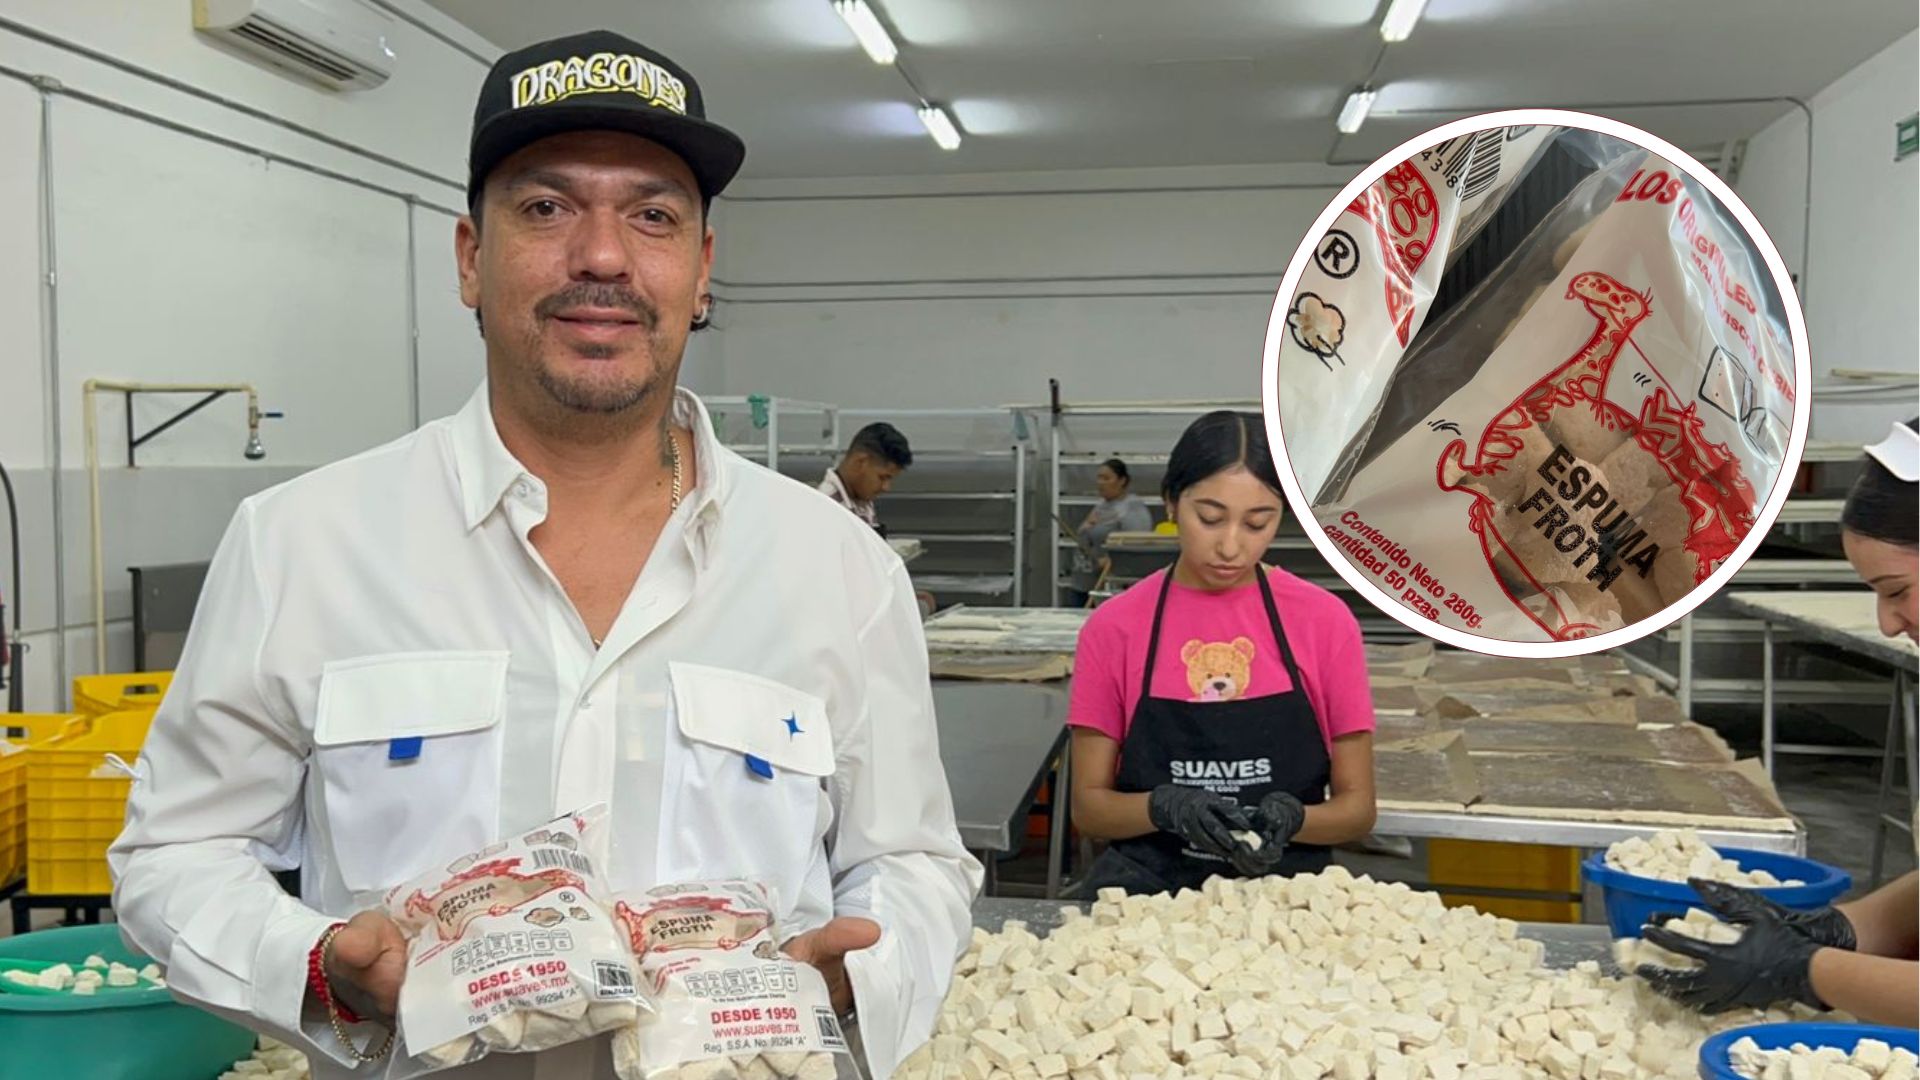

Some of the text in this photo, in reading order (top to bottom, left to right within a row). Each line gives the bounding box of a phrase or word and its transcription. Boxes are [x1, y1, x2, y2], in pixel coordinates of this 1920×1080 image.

[510, 52, 687, 116] DRAGONES
[1615, 169, 1685, 205] LOS
[1537, 443, 1660, 579] ESPUMA
[1517, 487, 1623, 593] FROTH
[1323, 525, 1440, 624] cantidad 50 pzas.
[1340, 511, 1482, 629] Contenido Neto 280g.
[1170, 758, 1271, 778] SUAVES
[437, 883, 496, 922] ESPUMA
[651, 914, 716, 935] ESPUMA
[660, 924, 713, 940] FROTH
[526, 960, 566, 977] 1950
[711, 1007, 797, 1024] DESDE 1950
[712, 1025, 800, 1039] www.suaves.mx
